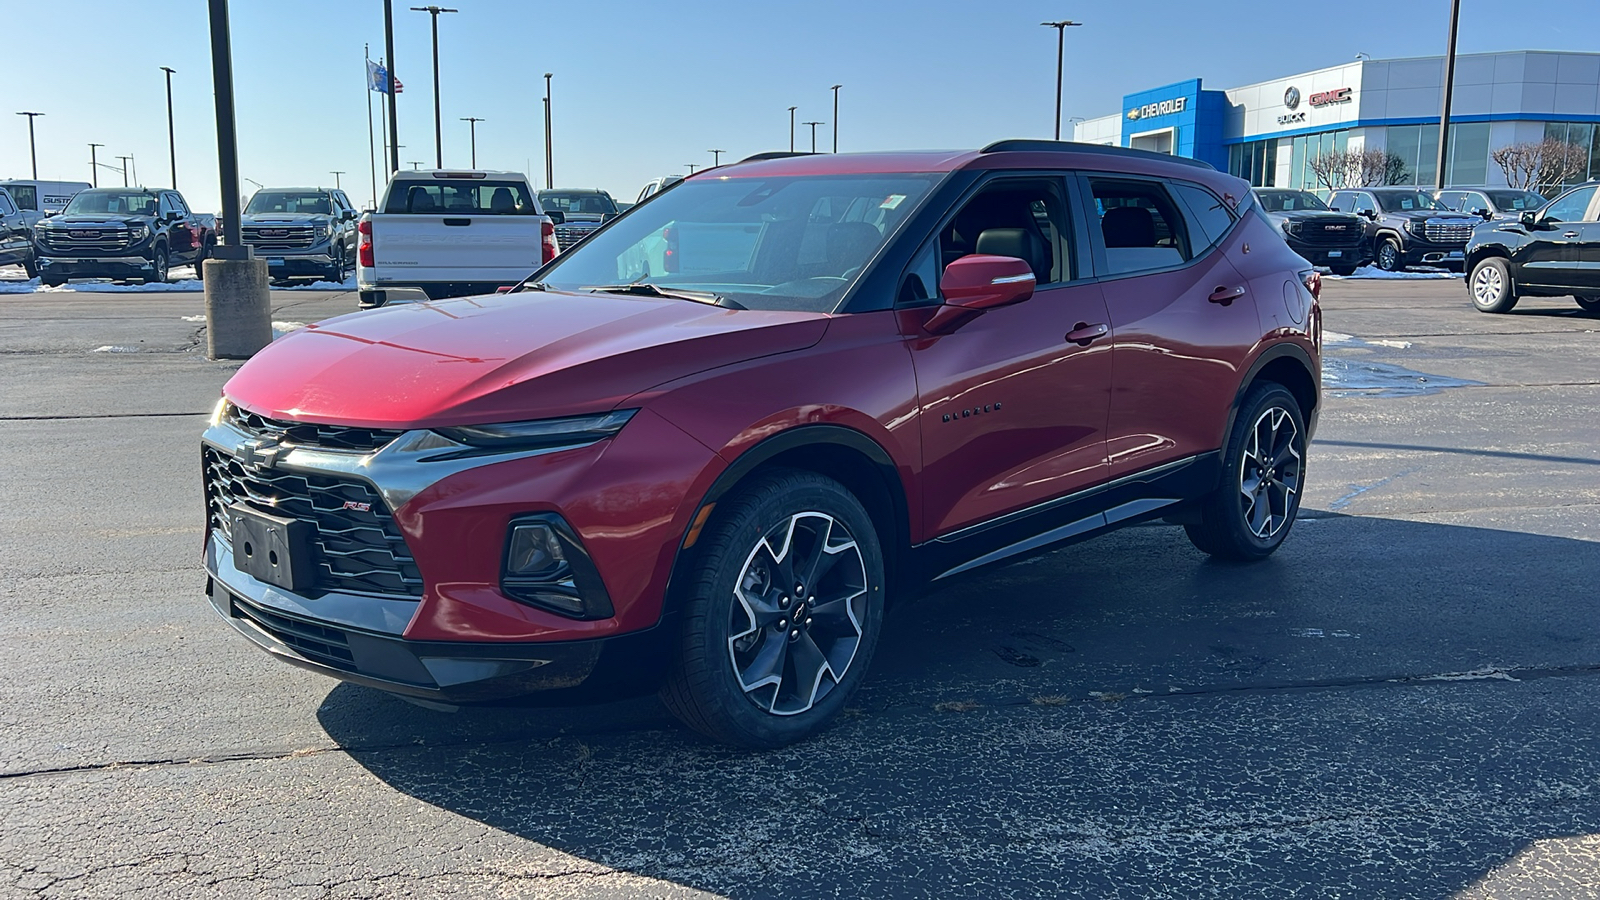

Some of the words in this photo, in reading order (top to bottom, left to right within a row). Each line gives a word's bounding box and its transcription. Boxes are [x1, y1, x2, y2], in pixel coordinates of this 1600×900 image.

[1309, 87, 1352, 107] GMC
[1141, 97, 1187, 118] CHEVROLET
[1277, 112, 1306, 125] BUICK
[69, 230, 101, 238] GMC
[942, 402, 1001, 422] BLAZER
[343, 501, 370, 511] RS
